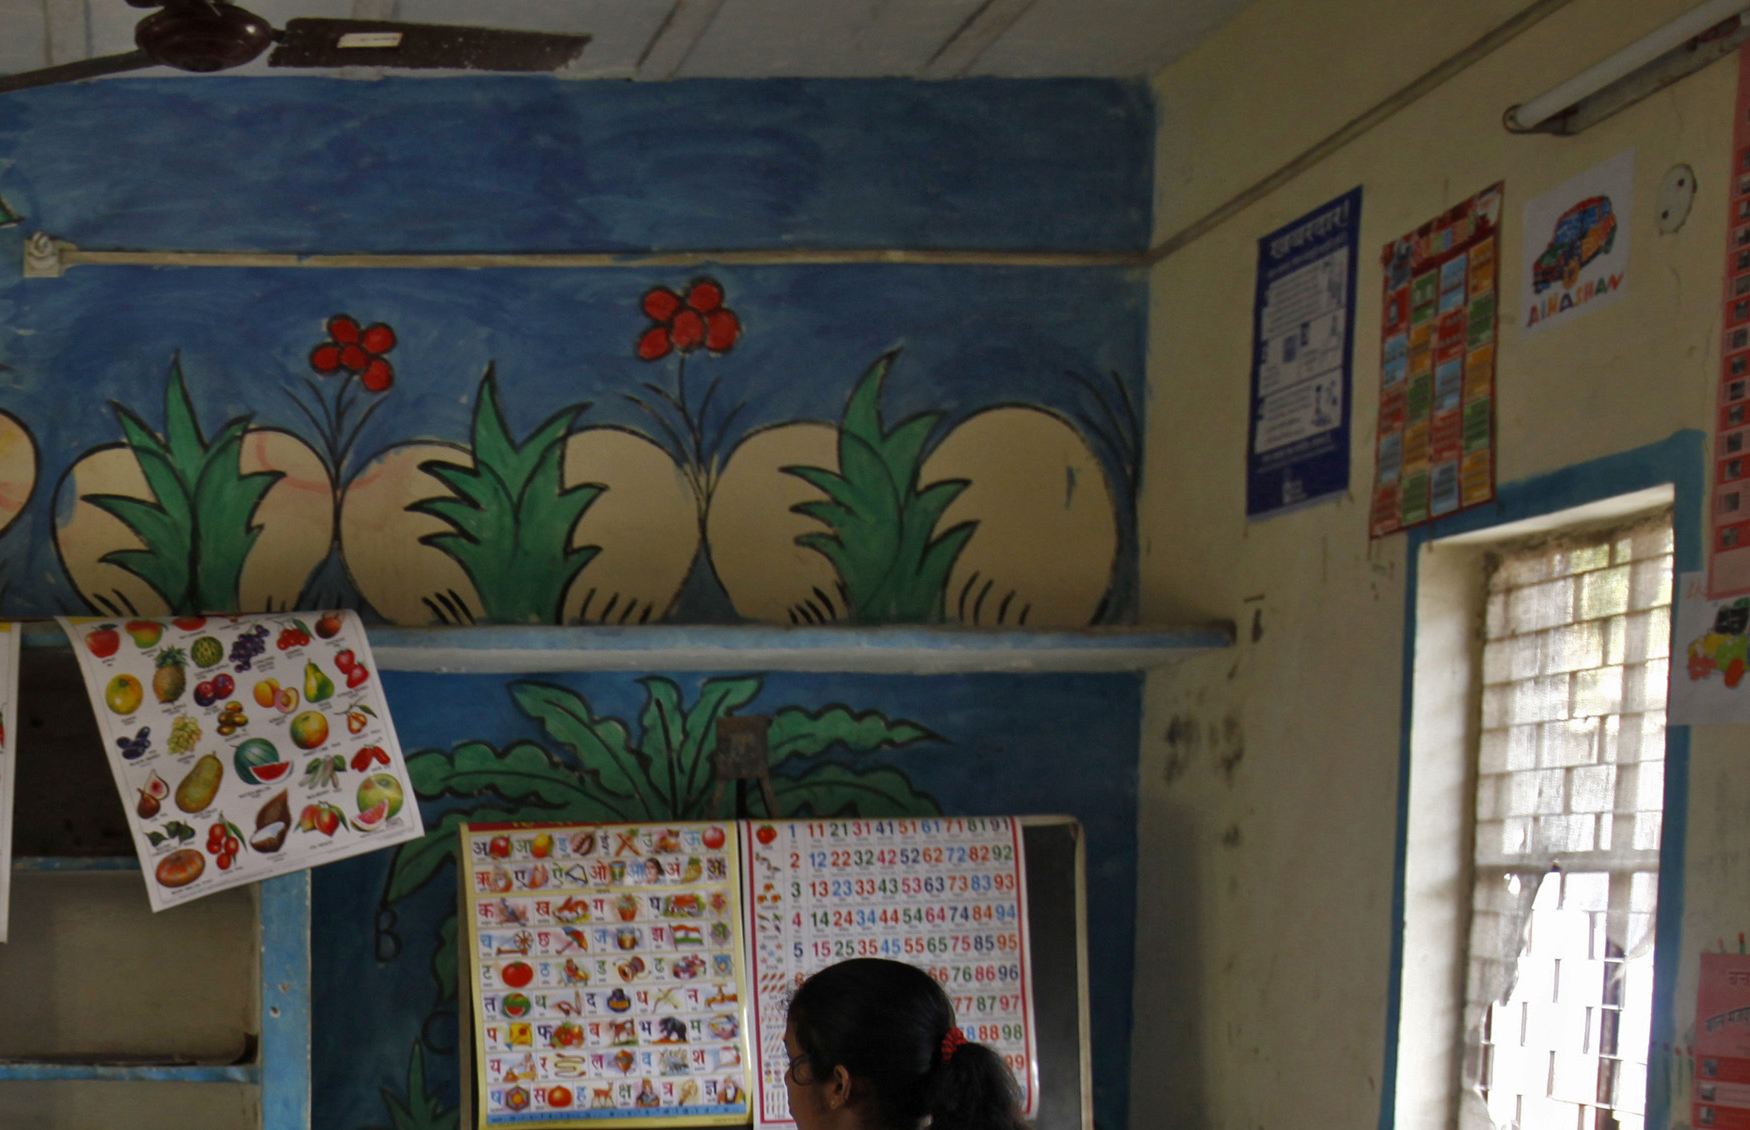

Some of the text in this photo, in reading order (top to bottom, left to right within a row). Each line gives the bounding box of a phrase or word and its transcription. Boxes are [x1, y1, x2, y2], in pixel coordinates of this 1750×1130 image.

[788, 819, 1008, 838] 1 11 21 31 41 51 61 71 81 91
[790, 846, 1012, 868] 2 12 22 32 42 52 62 72 82 92
[791, 874, 1015, 897] 3 13 23 33 43 53 63 73 83 93
[478, 903, 494, 918] क
[535, 901, 550, 916] ख
[593, 899, 604, 914] ग
[792, 905, 1016, 927] 4 14 24 34 44 54 64 74 84 94
[537, 932, 550, 947] छ
[594, 929, 607, 944] ज
[794, 934, 1018, 957] 5 15 25 35 45 55 65 75 85 95
[952, 966, 972, 981] 76
[975, 966, 995, 980] 86
[998, 966, 1019, 980] 96
[484, 997, 496, 1012] त
[586, 993, 596, 1008] द
[687, 989, 698, 1004] न
[953, 995, 1020, 1011] 77 87 97
[487, 1027, 497, 1042] प
[537, 1025, 552, 1040] फ
[589, 1023, 600, 1038] ब
[690, 1019, 701, 1034] म
[978, 1025, 999, 1040] 88
[1002, 1024, 1023, 1039] 98
[489, 1059, 501, 1074] य
[540, 1056, 548, 1072] र
[591, 1054, 604, 1070] ल
[533, 1088, 546, 1104] स
